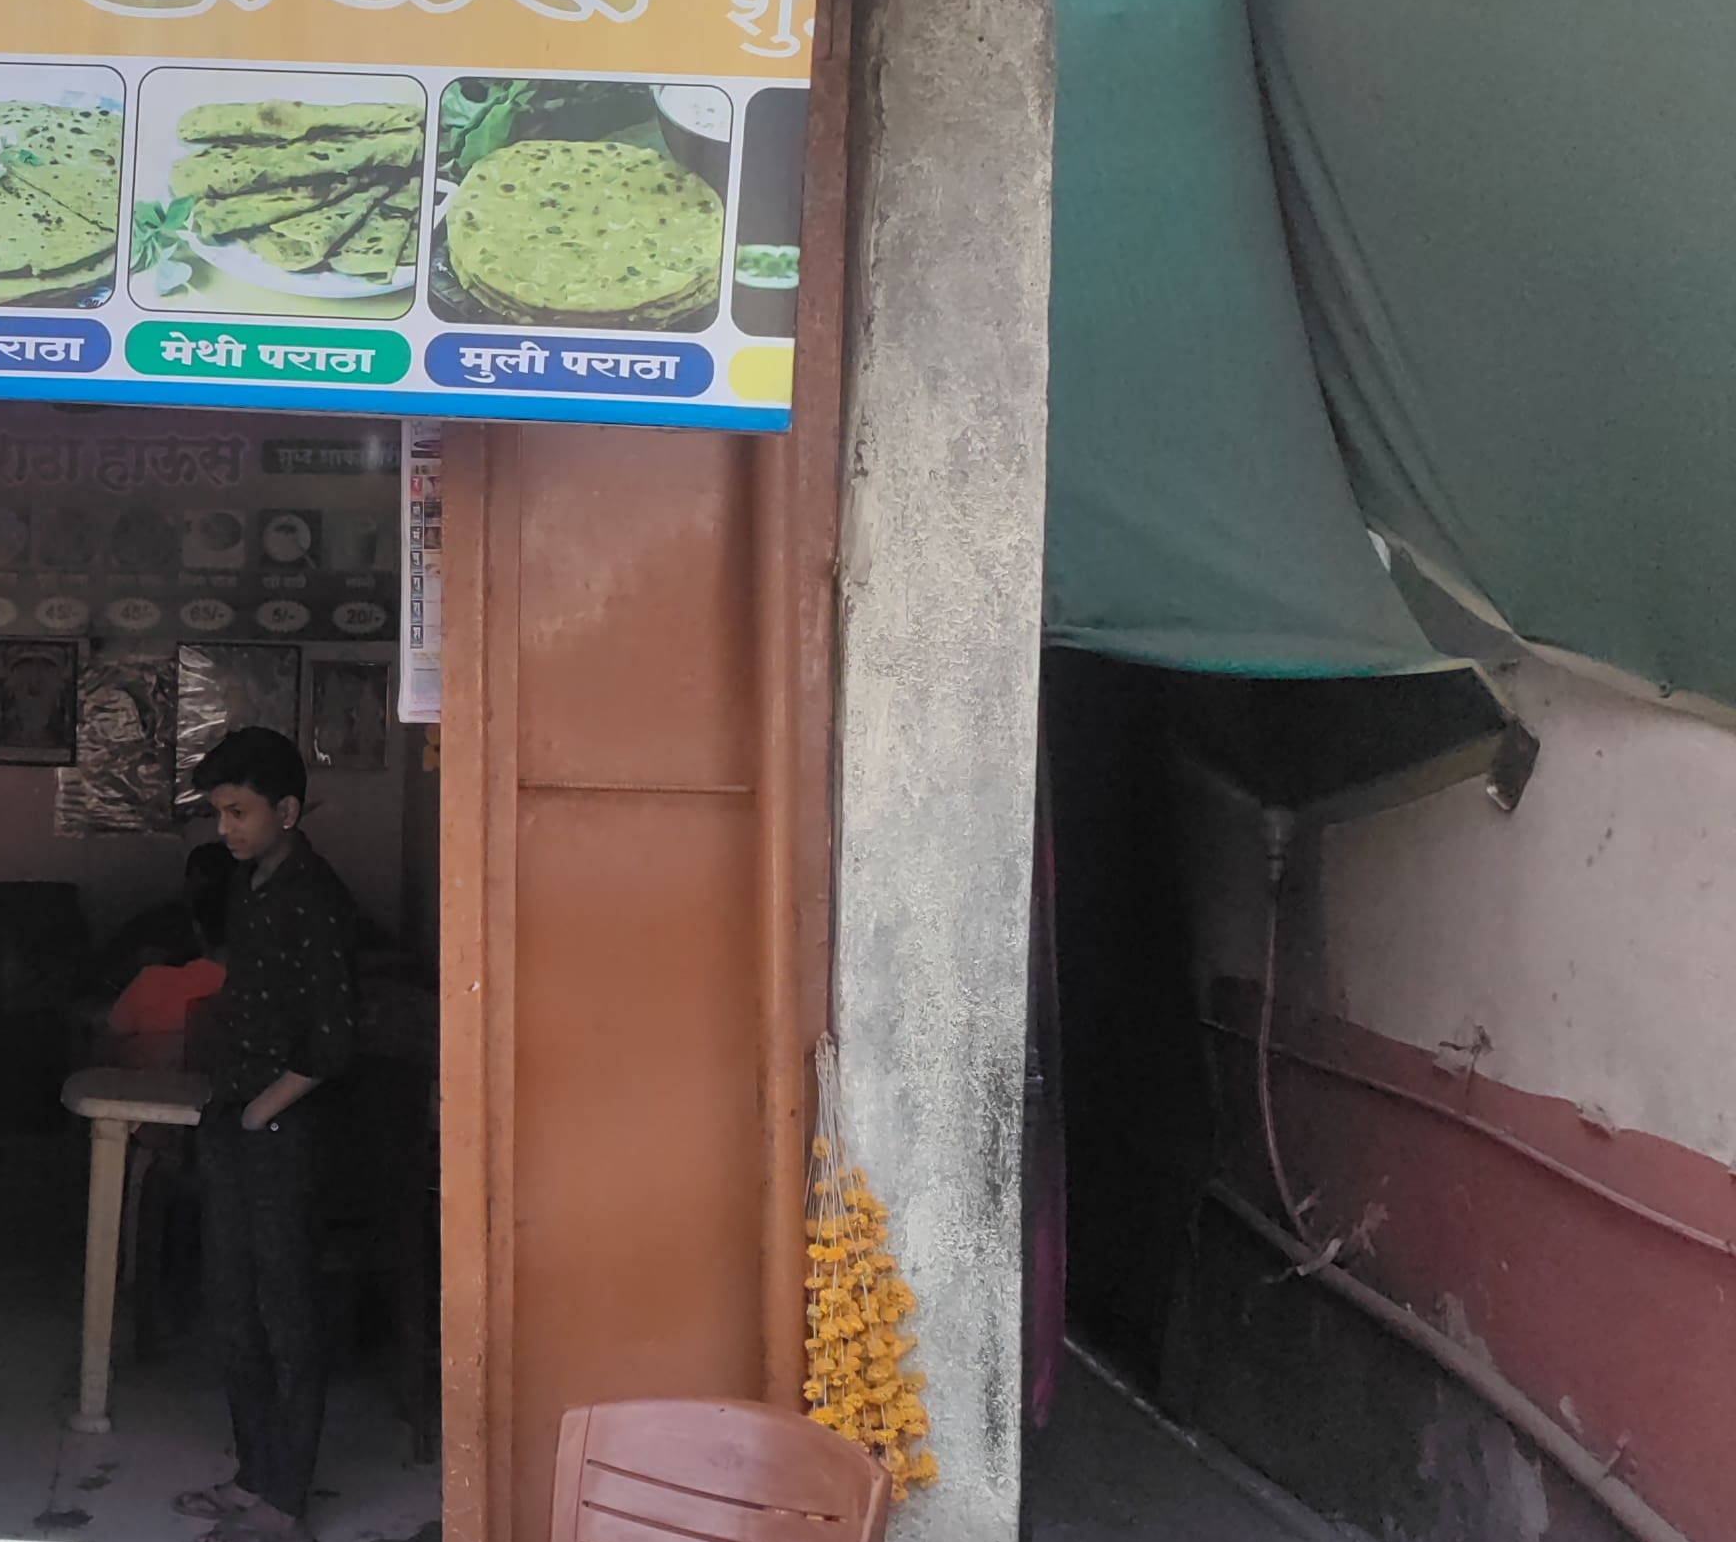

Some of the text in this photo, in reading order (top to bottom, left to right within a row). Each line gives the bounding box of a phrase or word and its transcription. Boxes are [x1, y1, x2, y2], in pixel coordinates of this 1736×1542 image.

[160, 330, 376, 374] मेथी पराठा
[459, 341, 681, 384] मुली पराठा
